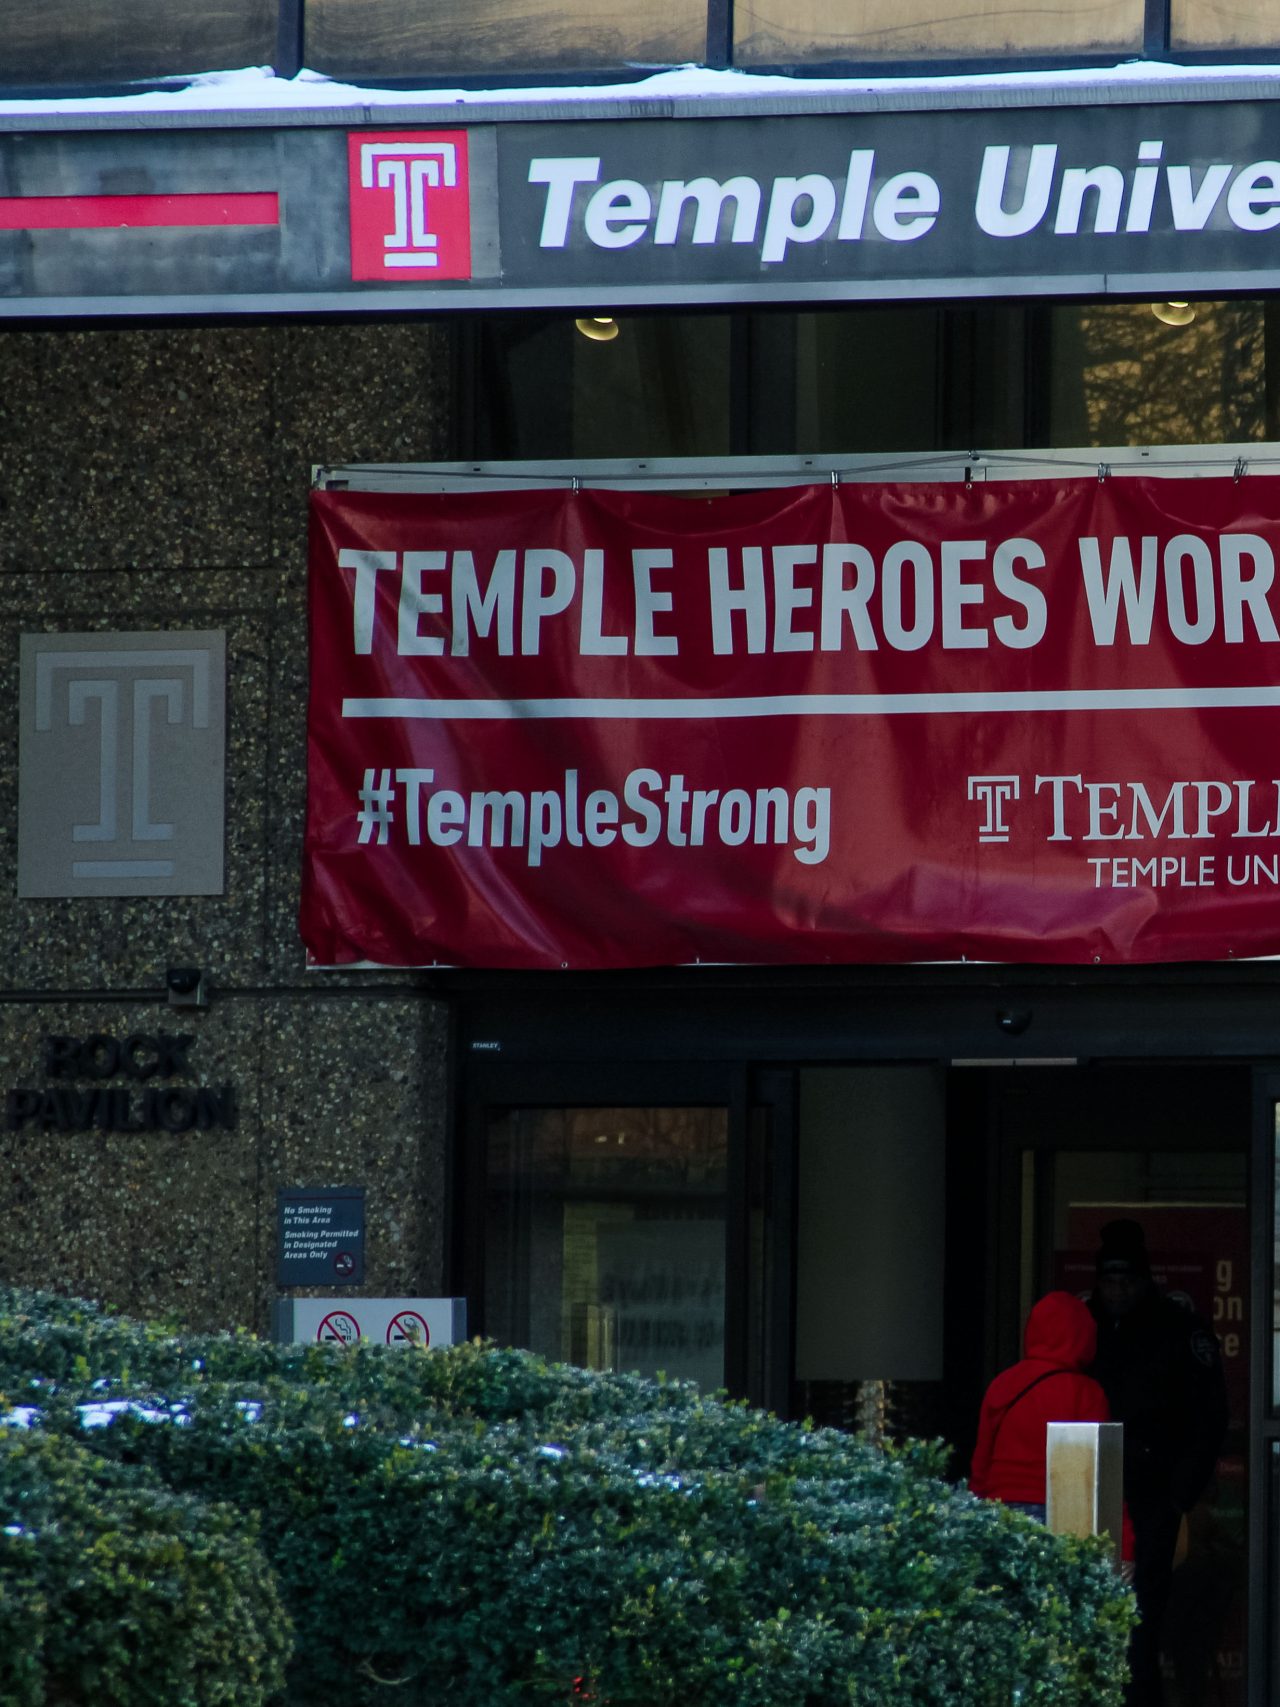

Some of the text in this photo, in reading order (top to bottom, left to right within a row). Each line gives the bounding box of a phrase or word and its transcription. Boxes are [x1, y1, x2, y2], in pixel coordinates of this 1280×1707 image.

[528, 149, 941, 263] Temple
[338, 548, 679, 657] TEMPLE
[708, 538, 1048, 655] HEROES
[357, 768, 831, 866] #TempleStrong
[1088, 856, 1215, 888] TEMPLE
[46, 1034, 197, 1081] ROCK
[8, 1087, 235, 1133] PAVILION
[293, 1216, 310, 1224] This
[312, 1216, 331, 1224] Area
[298, 1206, 332, 1215] Smoking
[285, 1229, 359, 1239] Smoking Permitted
[293, 1241, 338, 1250] Designated
[284, 1250, 328, 1260] Areas Only
